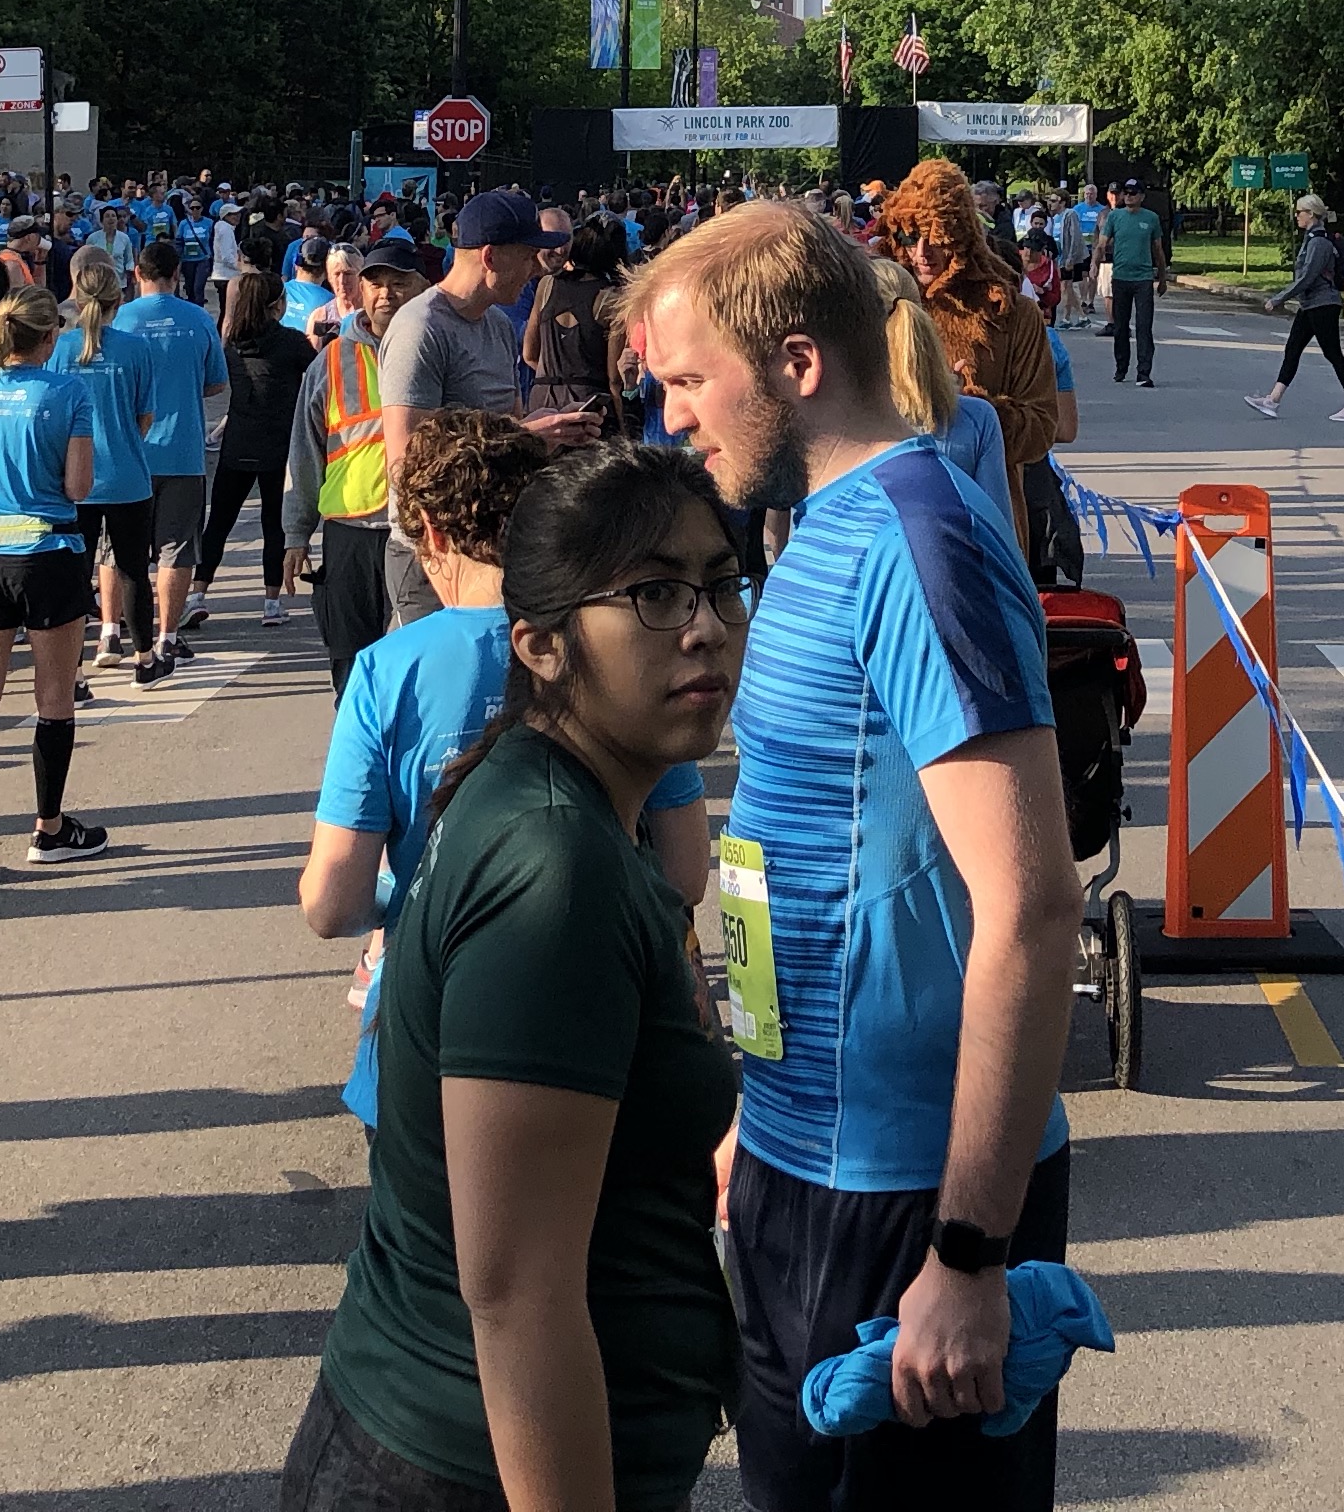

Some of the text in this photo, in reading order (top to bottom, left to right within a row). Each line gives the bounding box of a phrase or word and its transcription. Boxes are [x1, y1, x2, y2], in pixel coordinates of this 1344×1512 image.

[10, 100, 37, 110] ZONE
[683, 115, 790, 129] LINCOLN PARK ZOO
[966, 114, 1058, 127] LINCOLN PARK ZOO
[430, 118, 483, 142] STOP
[966, 128, 978, 136] FOR
[684, 133, 698, 142] FOR
[735, 132, 749, 141] FOR
[723, 839, 746, 866] 2550
